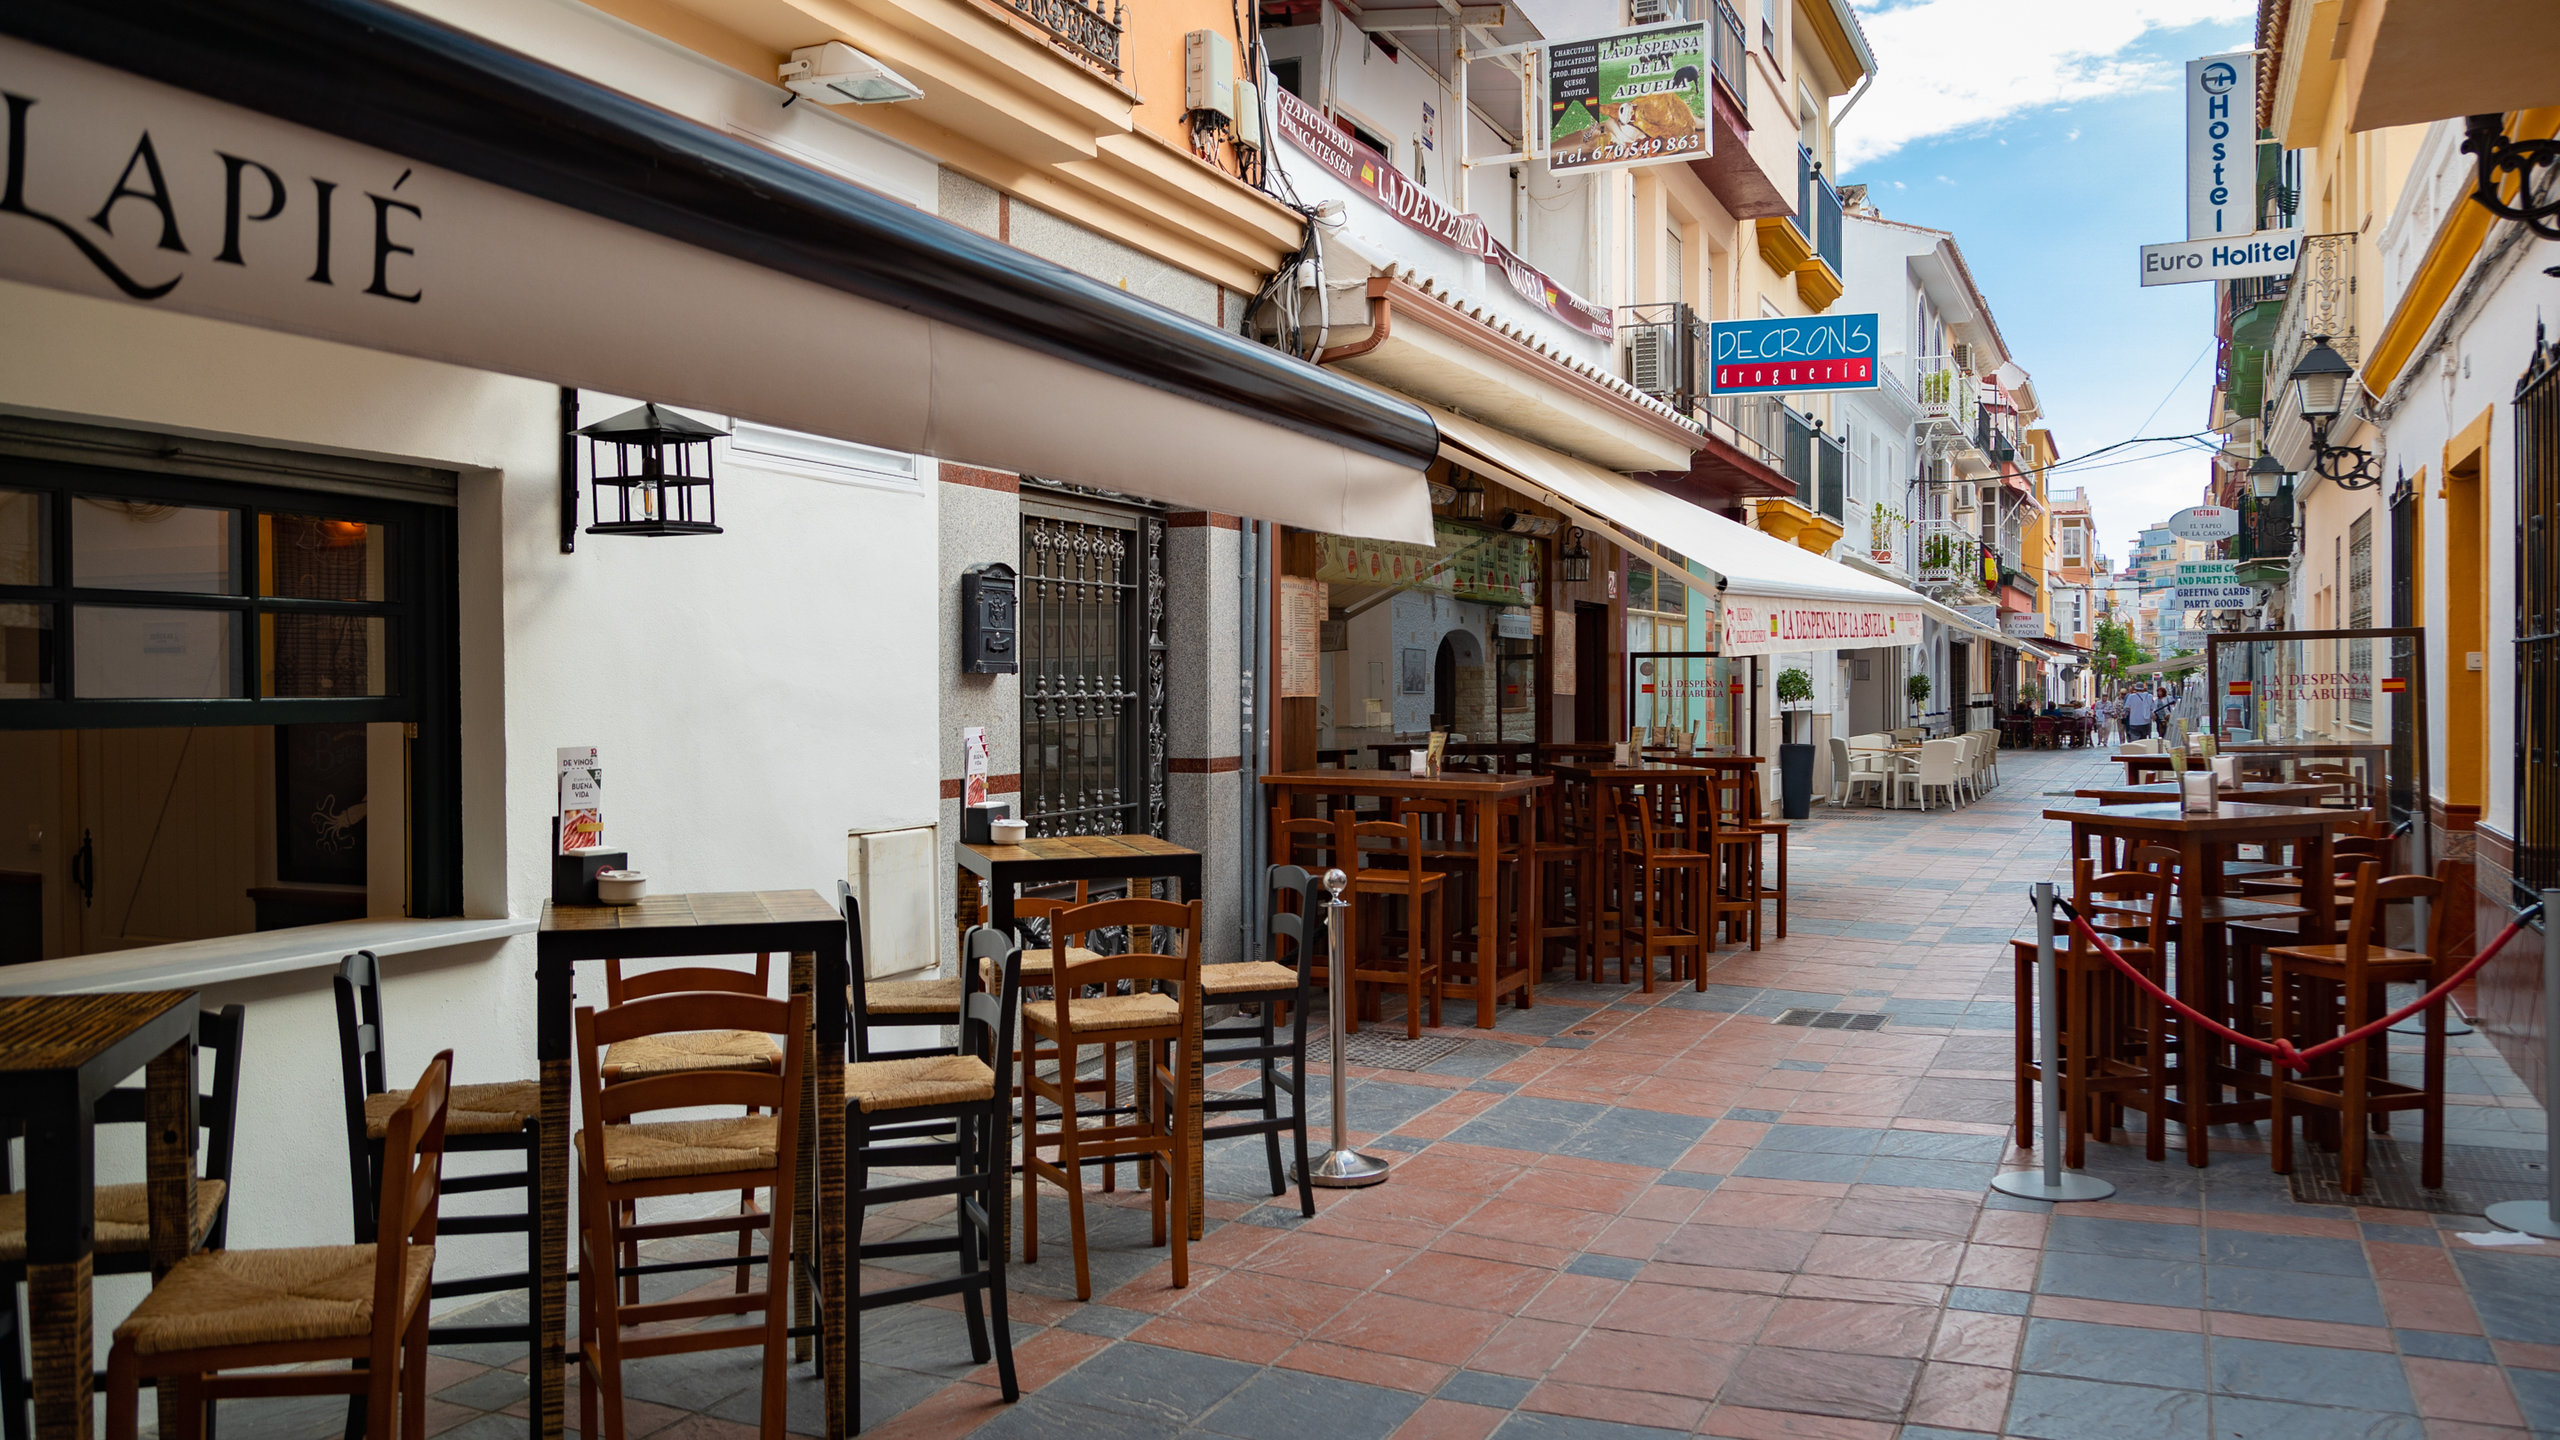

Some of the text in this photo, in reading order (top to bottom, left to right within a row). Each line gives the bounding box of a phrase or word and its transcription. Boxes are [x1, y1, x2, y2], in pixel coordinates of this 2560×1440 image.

[1554, 45, 1595, 57] CHARCUTERIA
[1602, 36, 1699, 60] LA DESPENSA
[1553, 55, 1597, 68] DELICATESSEN
[1630, 60, 1672, 76] DE LA
[1552, 65, 1597, 78] PROD. IBERICOS
[1563, 77, 1587, 88] QUESOS
[1614, 78, 1687, 97] ABUELA
[1560, 88, 1590, 98] VINOTECA
[1278, 91, 1354, 158] CHARCUTERIA
[1555, 134, 1699, 165] Tel. 670 549 863
[2208, 94, 2229, 232] Hostel
[1378, 166, 1396, 210] LA
[2146, 239, 2295, 272] Euro Holitel
[1718, 318, 1871, 360] DECRONS
[1721, 363, 1866, 385] droguería
[2180, 564, 2235, 574] THE IRISH CA
[2177, 577, 2194, 585] AND
[2196, 576, 2221, 585] PARTY
[2177, 587, 2250, 597] GREETING CARDS
[2184, 599, 2244, 609] PARTY GOODS
[1782, 610, 1887, 639] LA DESPENSA DE LA ABUELA
[1661, 680, 1724, 688] LA DESPENSA
[2263, 672, 2371, 686] LA DESPENSA
[1661, 689, 1724, 698] DE LA ABUELA
[2263, 688, 2371, 701] DE LA ABUELA
[573, 758, 594, 766] VINOS
[571, 782, 593, 790] BUENA
